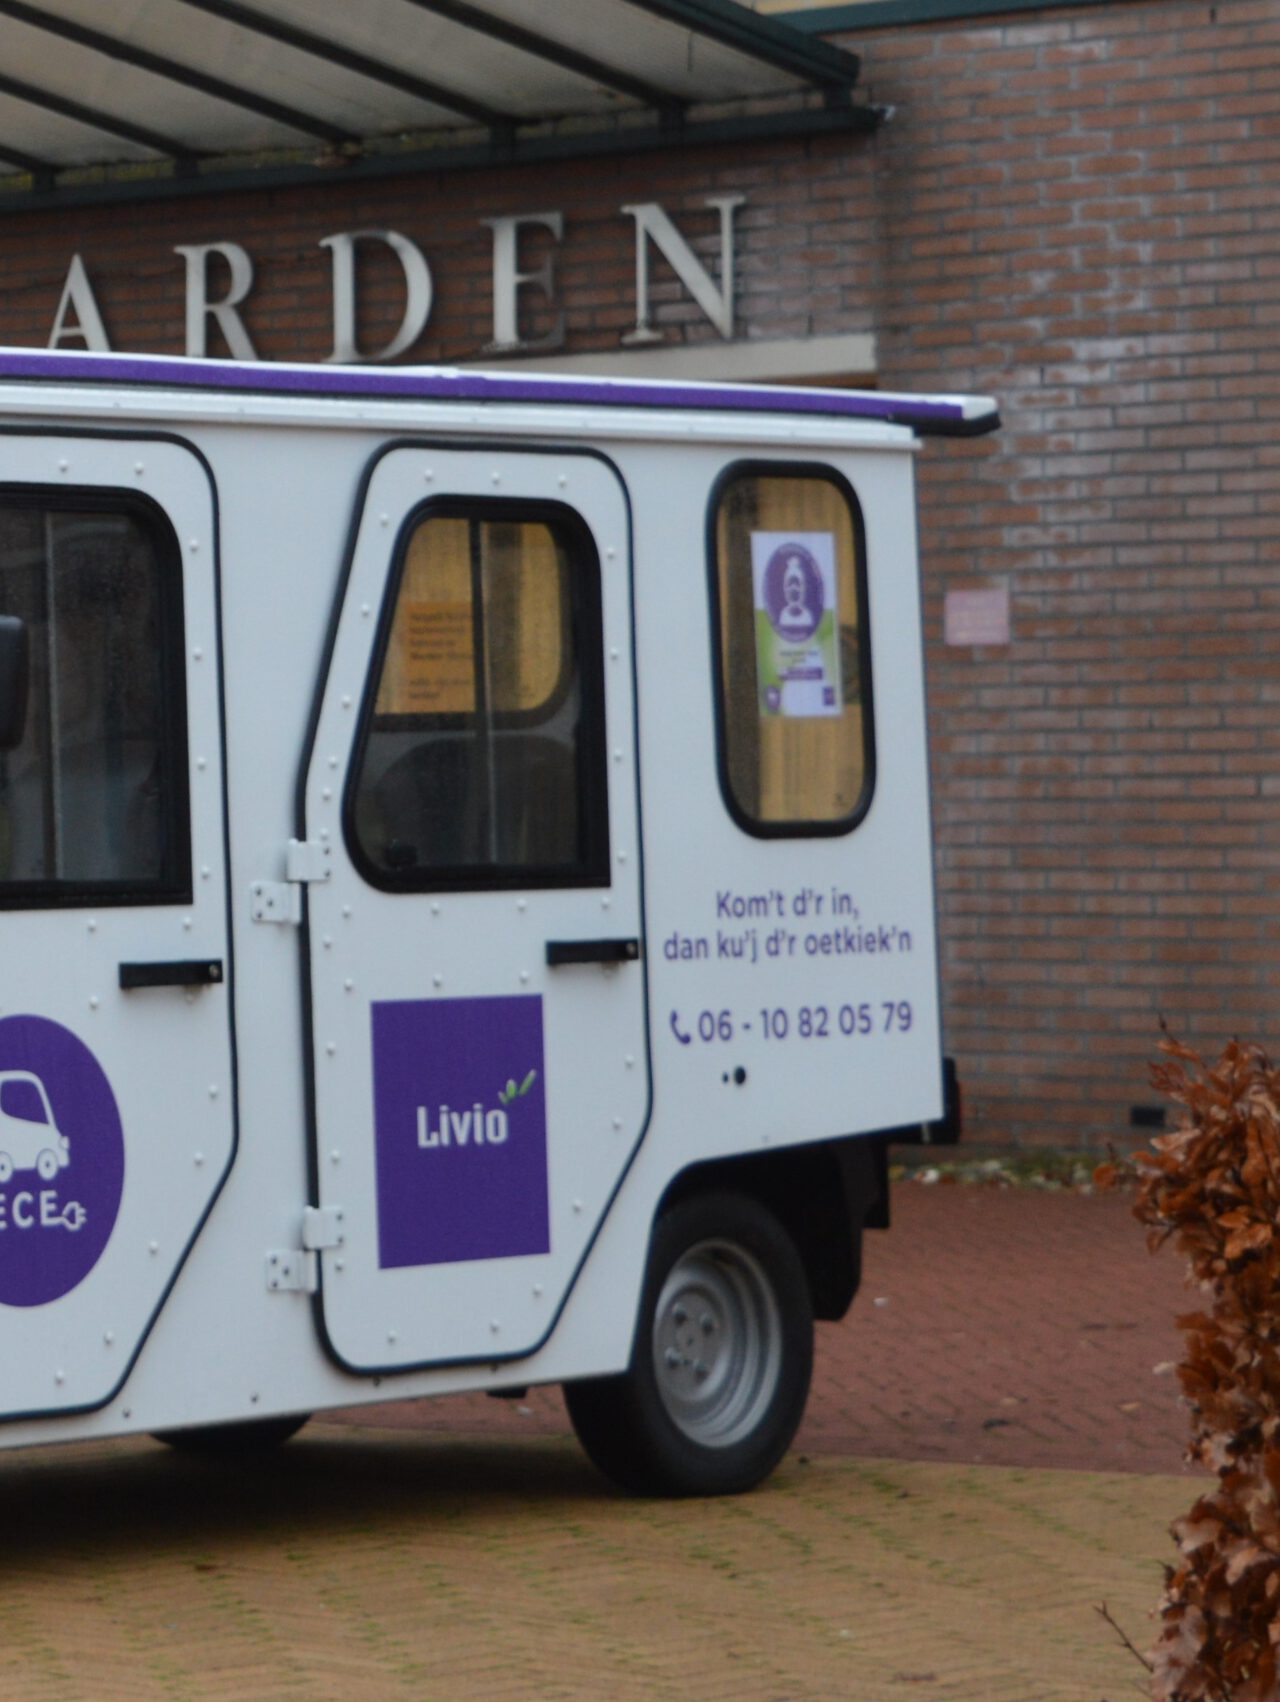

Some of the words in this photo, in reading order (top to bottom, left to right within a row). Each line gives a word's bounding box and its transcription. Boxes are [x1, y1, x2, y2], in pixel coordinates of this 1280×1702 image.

[717, 890, 784, 918] Kom't
[793, 888, 823, 917] d'r
[832, 887, 859, 919] in,
[664, 931, 708, 960] dan
[717, 929, 758, 963] ku'j
[765, 928, 797, 957] d'r
[804, 924, 911, 955] oetkiek'n
[698, 1009, 733, 1042] 06
[760, 1007, 789, 1040] 10
[798, 1005, 829, 1038] 82
[838, 1003, 872, 1036] 05
[881, 1000, 913, 1032] 79
[417, 1102, 509, 1148] Livio
